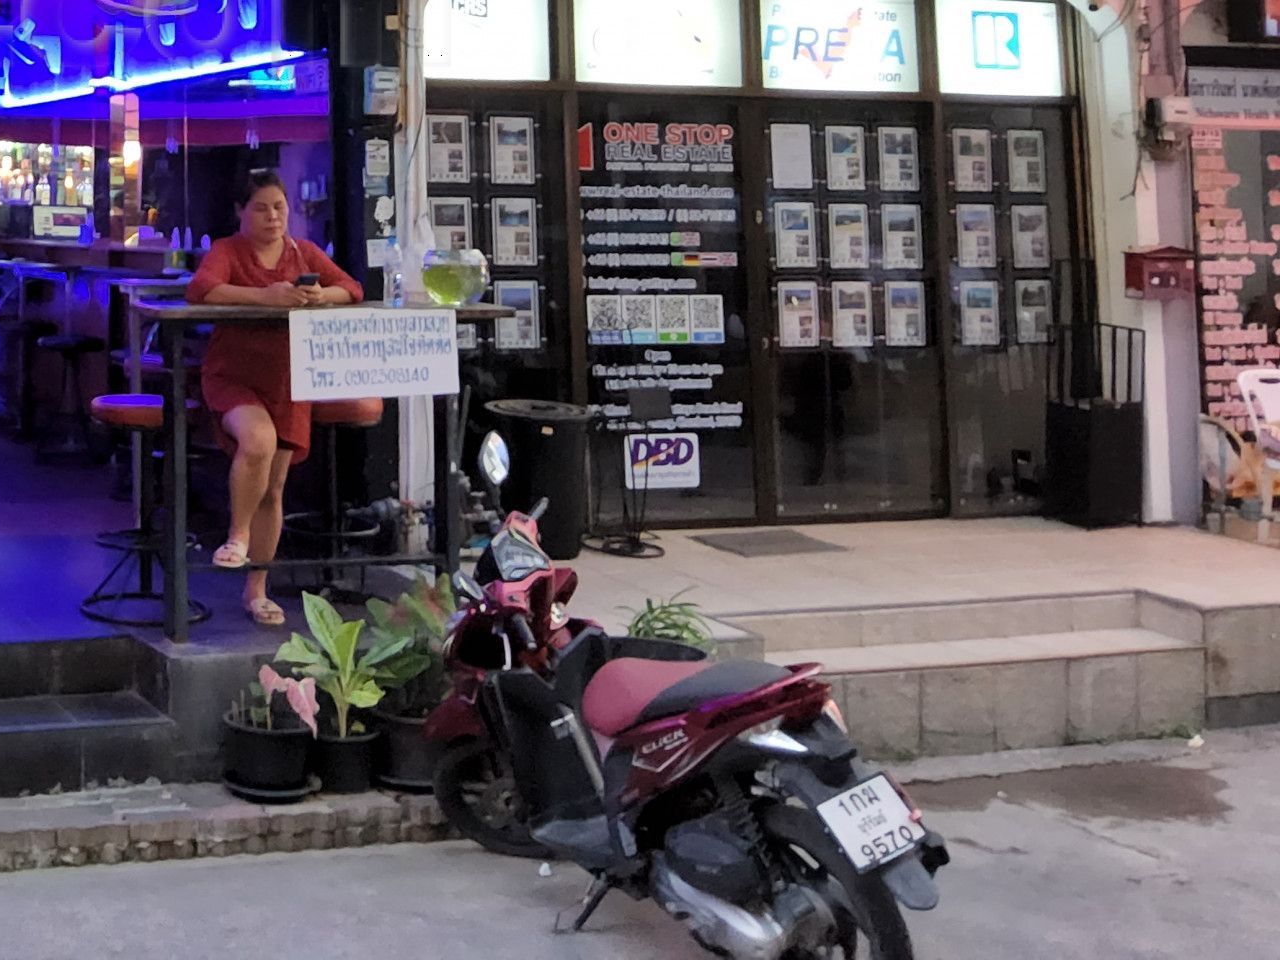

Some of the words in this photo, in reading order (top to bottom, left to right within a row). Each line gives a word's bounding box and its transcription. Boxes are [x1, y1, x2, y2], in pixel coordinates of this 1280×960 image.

[763, 24, 907, 66] PREA
[603, 122, 660, 144] ONE
[665, 123, 734, 145] STOP
[605, 144, 658, 161] REAL
[661, 145, 734, 162] ESTATE
[631, 437, 695, 467] DBD
[641, 728, 686, 754] CLICK
[860, 824, 915, 862] 9570
